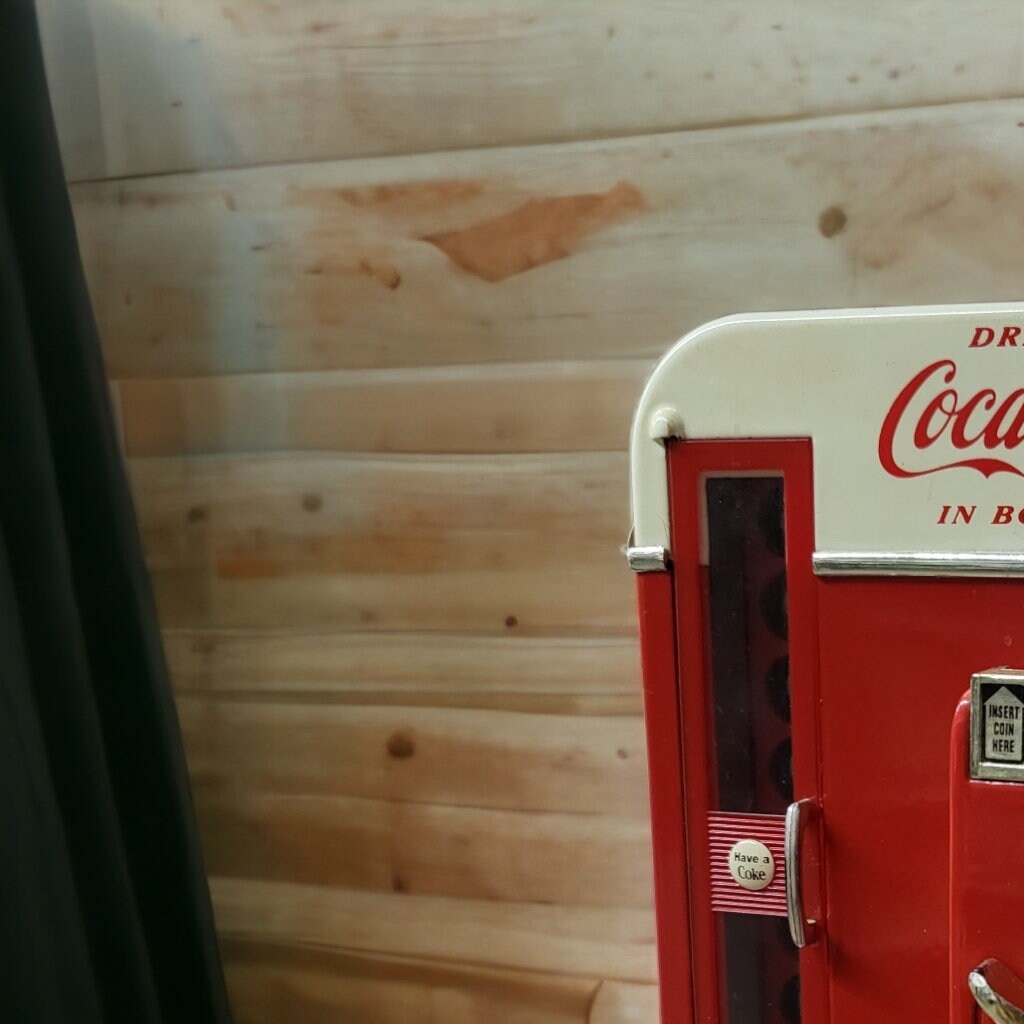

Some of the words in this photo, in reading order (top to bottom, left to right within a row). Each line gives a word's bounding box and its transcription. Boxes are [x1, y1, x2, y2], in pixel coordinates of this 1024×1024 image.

[937, 505, 977, 525] IN
[989, 704, 1020, 719] INSERT
[993, 722, 1014, 736] COIN
[992, 739, 1015, 753] HERE
[734, 852, 759, 864] Have
[762, 856, 770, 864] a
[737, 865, 766, 881] Coke
